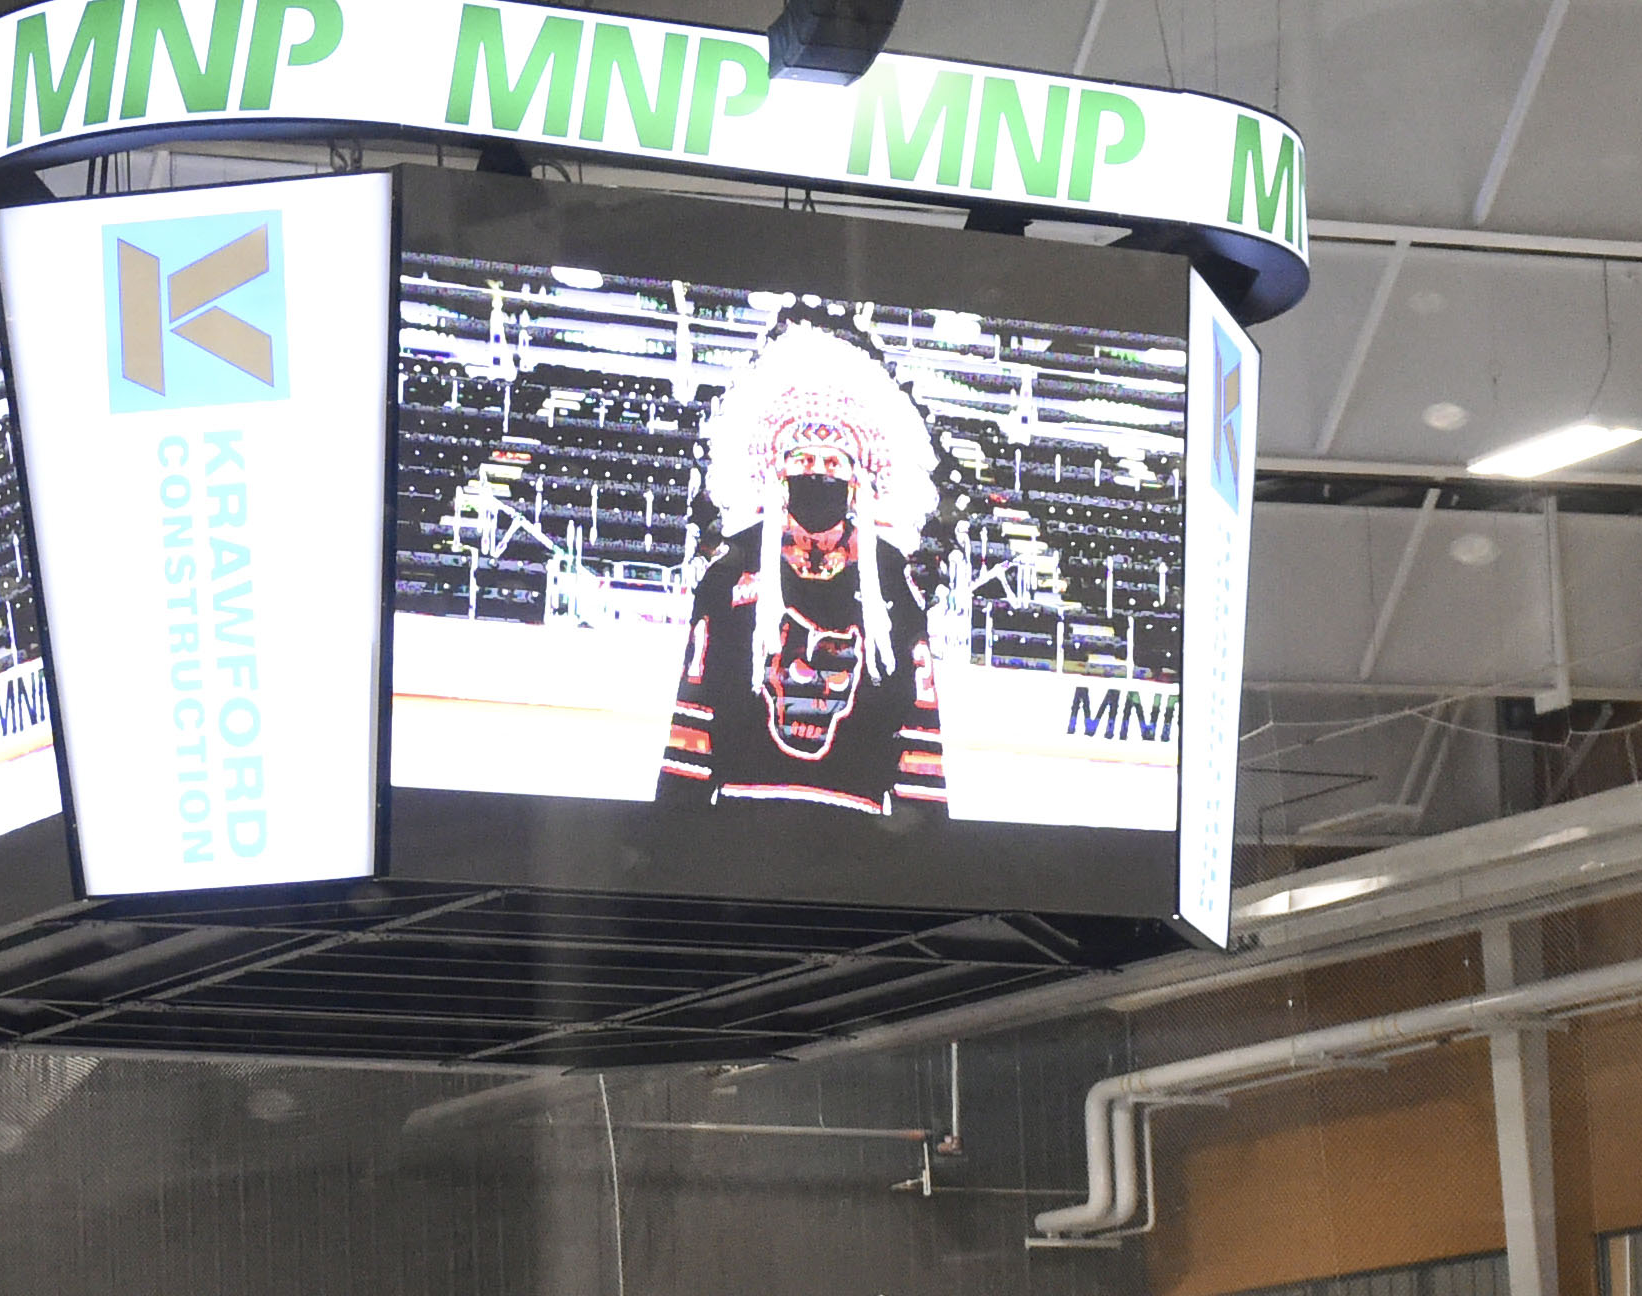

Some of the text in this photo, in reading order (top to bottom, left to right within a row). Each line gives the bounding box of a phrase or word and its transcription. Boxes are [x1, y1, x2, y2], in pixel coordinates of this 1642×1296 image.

[6, 0, 344, 148] MNP
[445, 3, 770, 156] MNP
[846, 61, 1147, 203] MNP
[1226, 115, 1307, 252] M
[157, 435, 215, 865] CONSTRUCTION
[202, 428, 267, 858] KRAWFORD
